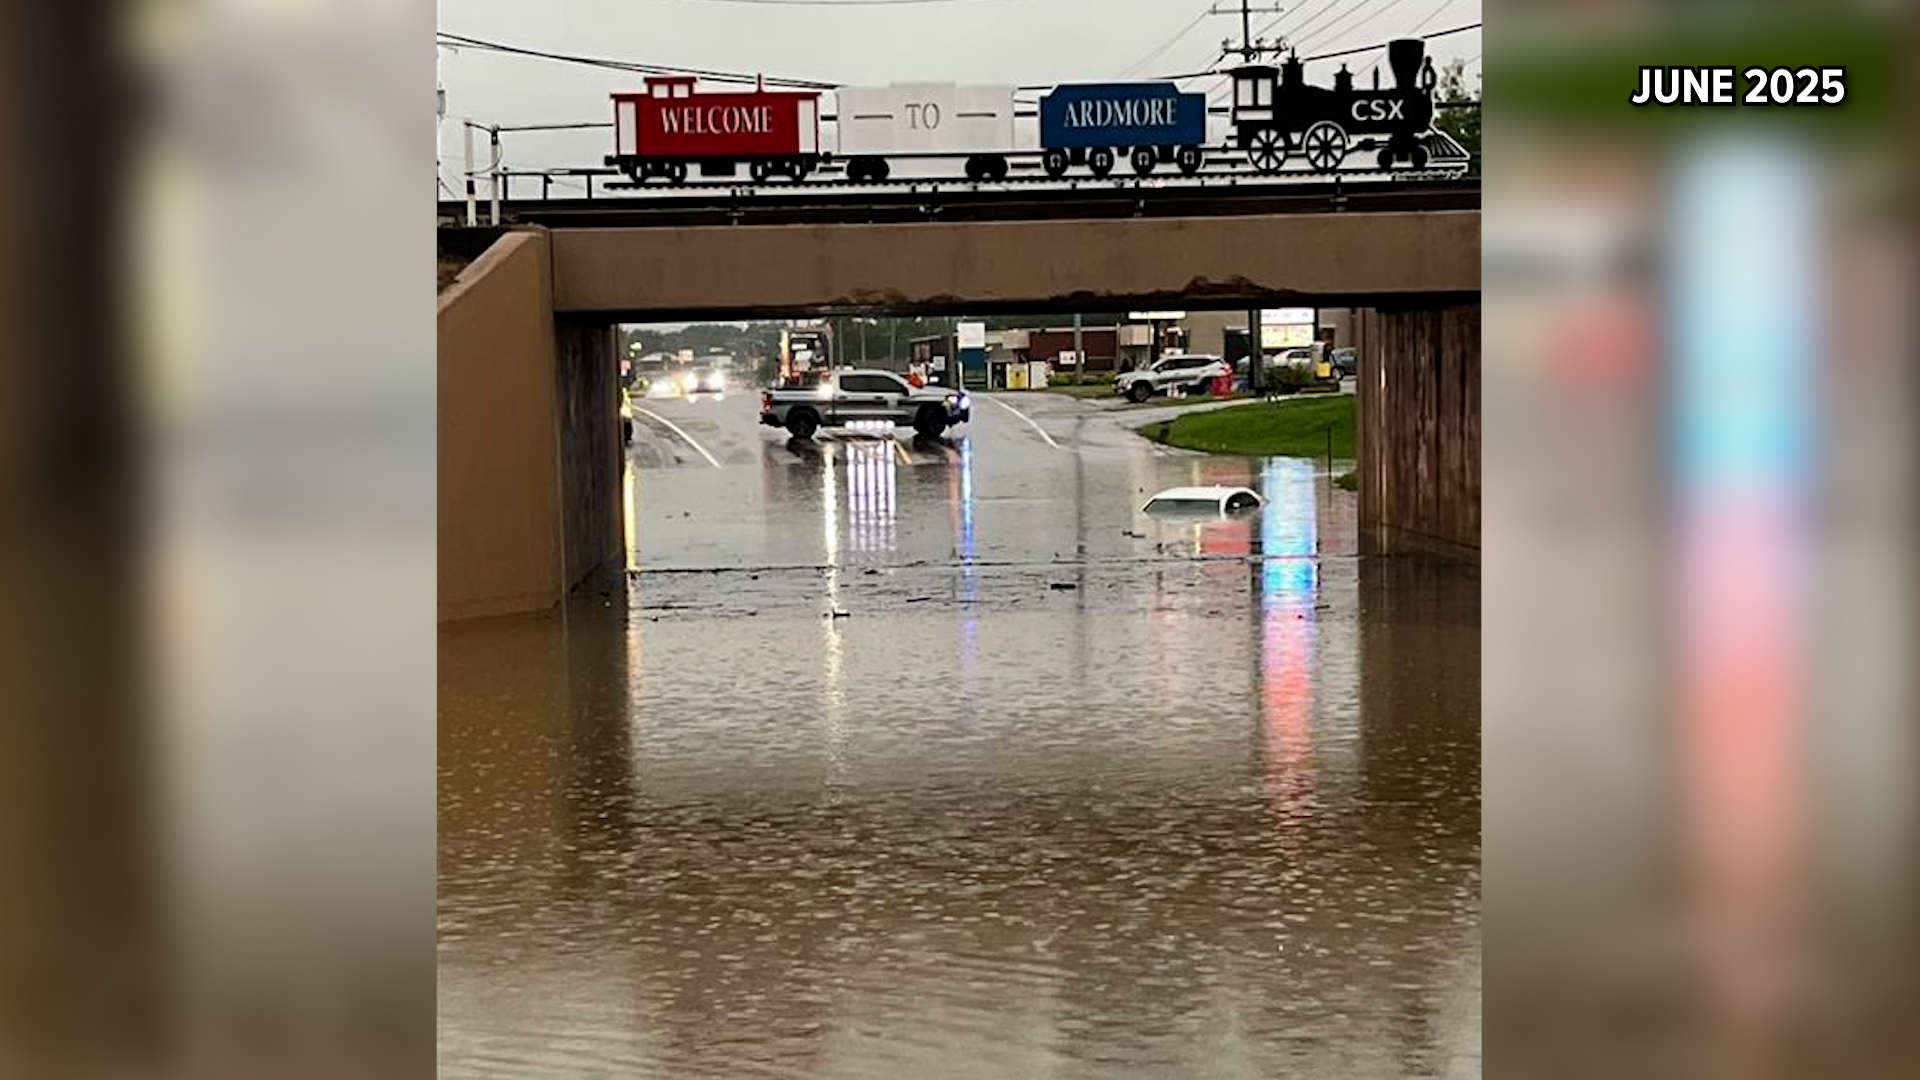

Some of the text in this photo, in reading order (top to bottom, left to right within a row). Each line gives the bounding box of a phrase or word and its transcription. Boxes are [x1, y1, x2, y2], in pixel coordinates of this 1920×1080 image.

[660, 98, 1177, 135] WELCOME TO ARDMORE
[1351, 100, 1405, 121] CSX
